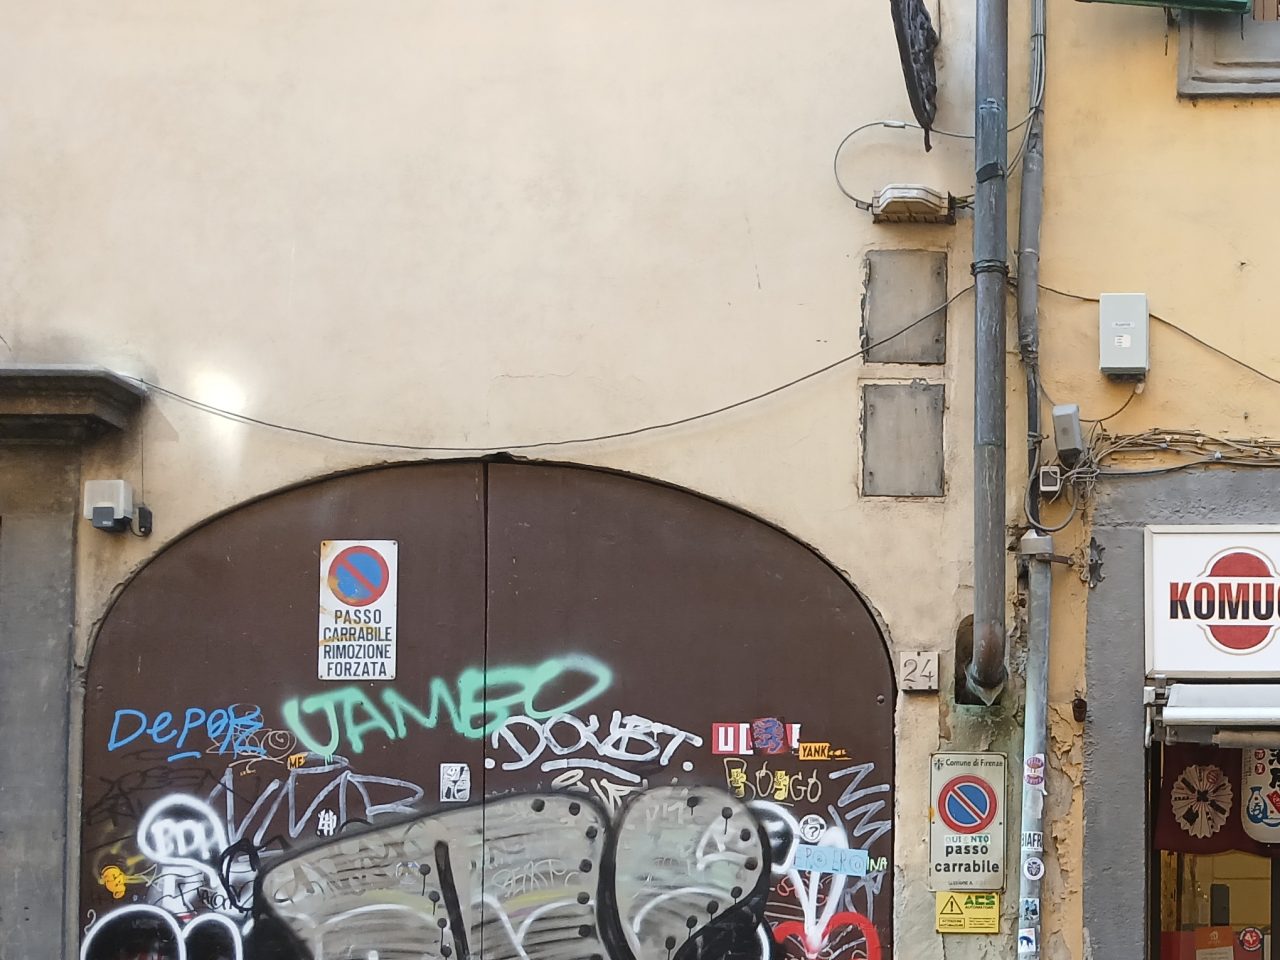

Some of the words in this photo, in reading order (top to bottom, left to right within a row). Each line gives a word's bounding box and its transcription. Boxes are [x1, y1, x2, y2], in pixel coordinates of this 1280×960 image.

[334, 608, 382, 625] PASSO
[323, 626, 392, 642] CARRABILE
[323, 644, 392, 660] RIMOZIONE
[327, 661, 387, 677] FORZATA
[903, 658, 936, 683] 24
[946, 758, 972, 767] Comune
[945, 844, 989, 857] passo
[935, 860, 1000, 873] carrabile
